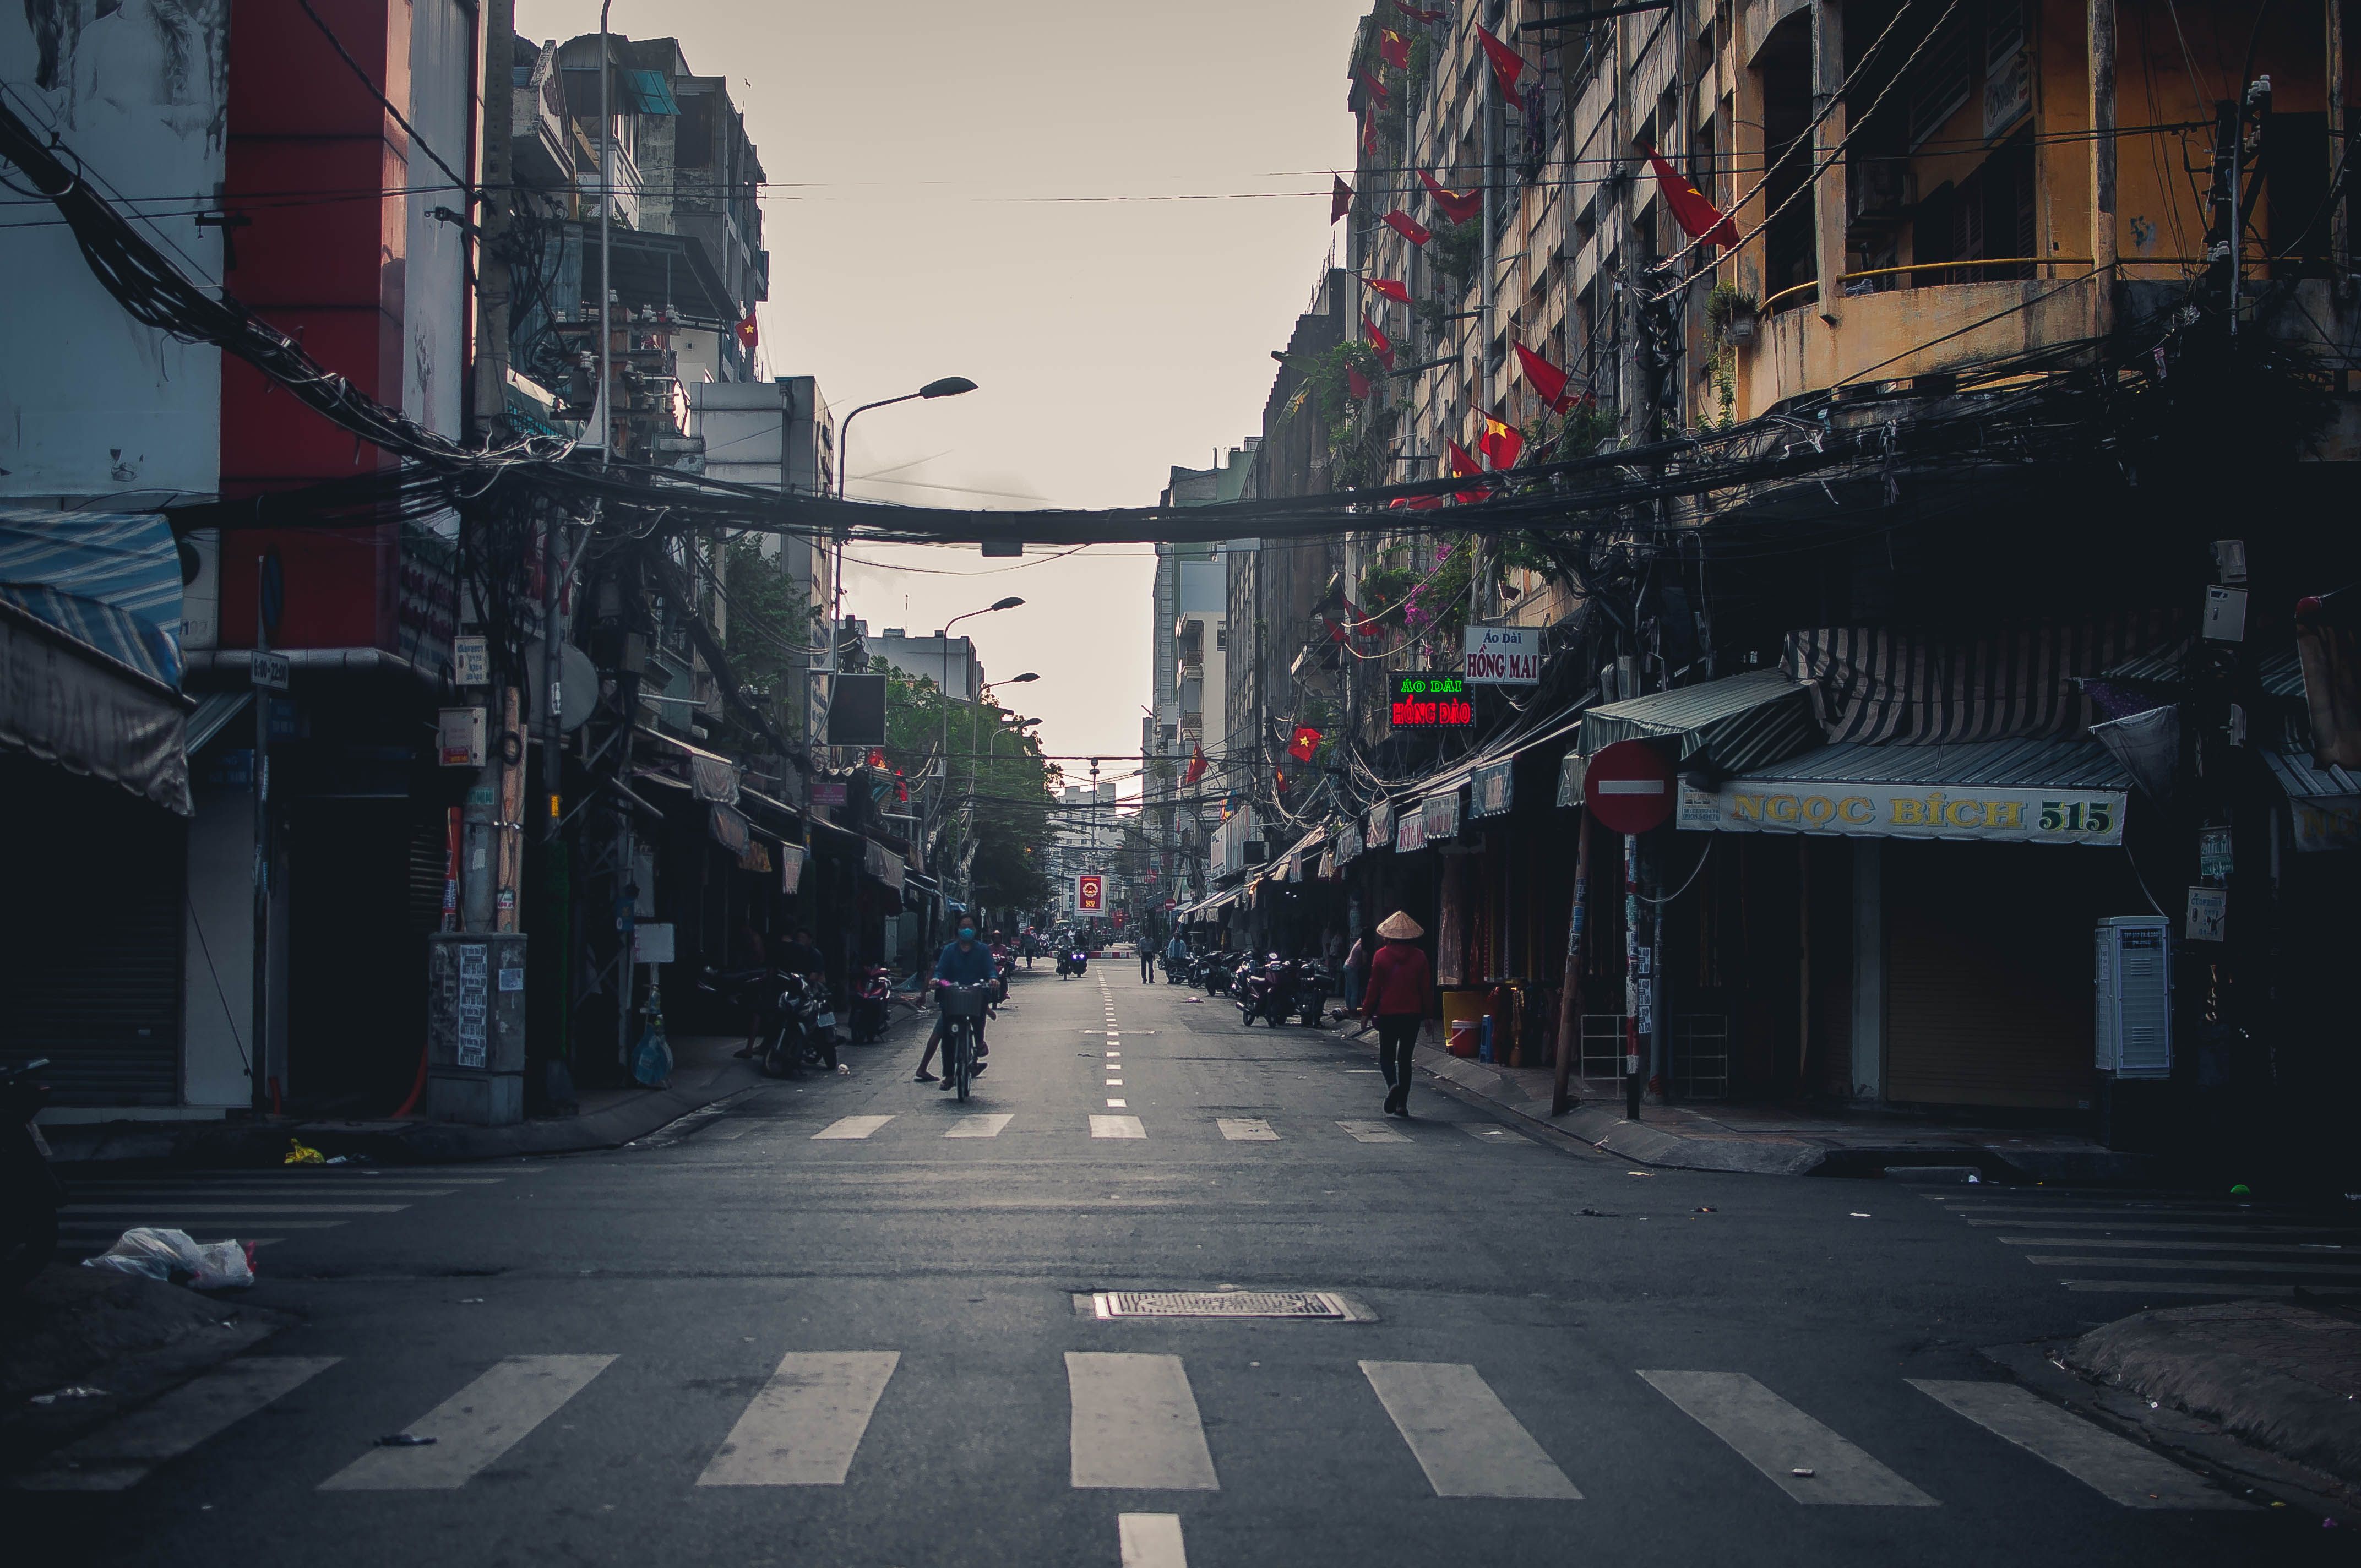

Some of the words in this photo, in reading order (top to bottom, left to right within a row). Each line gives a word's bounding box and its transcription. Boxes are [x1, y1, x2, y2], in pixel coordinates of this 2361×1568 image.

[1483, 629, 1499, 643] Áo
[1502, 632, 1522, 644] Dài
[1466, 643, 1505, 678] HỒNG
[1509, 654, 1538, 679] MAI
[1401, 678, 1426, 692] ÁO
[1430, 678, 1462, 692] DÀI
[1731, 793, 1876, 829] NGỌC
[1889, 792, 2030, 829] BÍCH
[2039, 800, 2115, 834] 515
